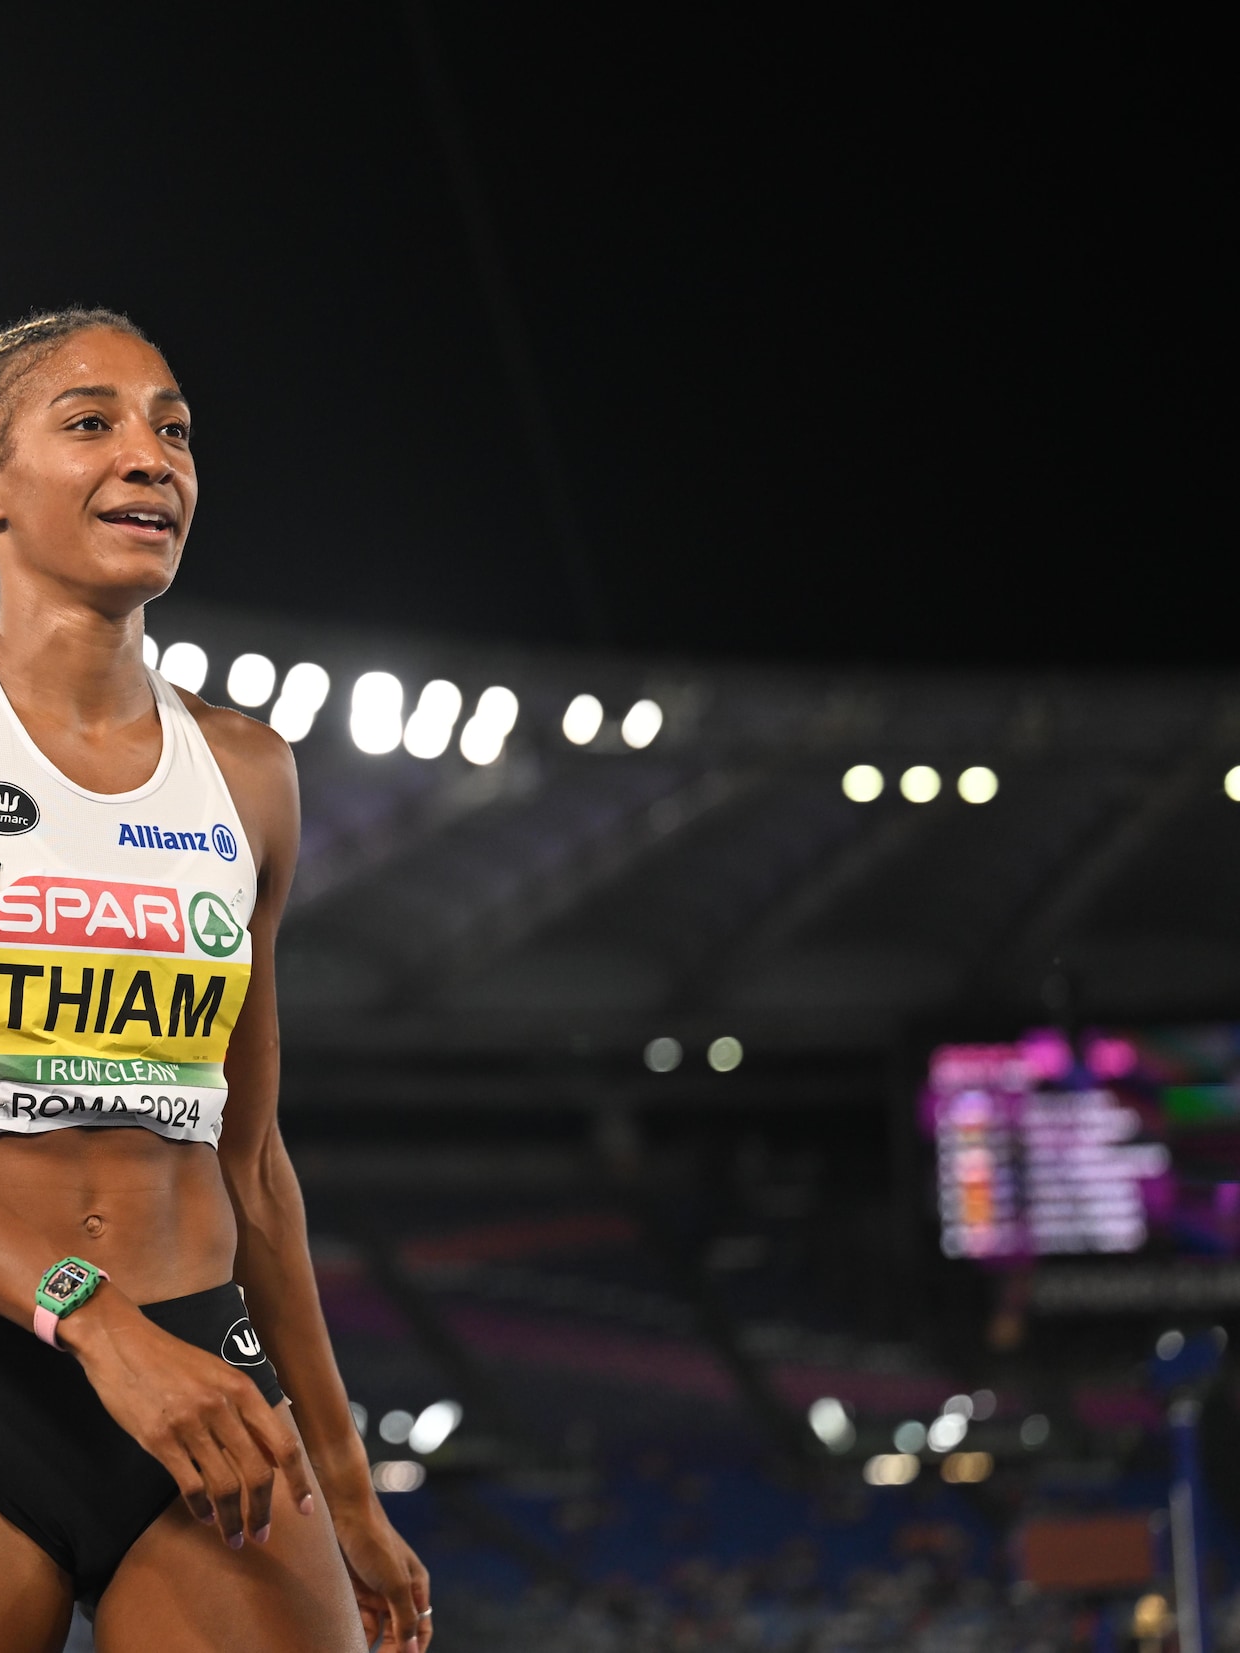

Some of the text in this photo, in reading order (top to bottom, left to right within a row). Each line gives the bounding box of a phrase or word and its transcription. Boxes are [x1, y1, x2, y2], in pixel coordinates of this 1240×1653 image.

[118, 823, 210, 852] Allianz
[36, 1059, 42, 1081] I
[50, 1059, 101, 1082] RUN
